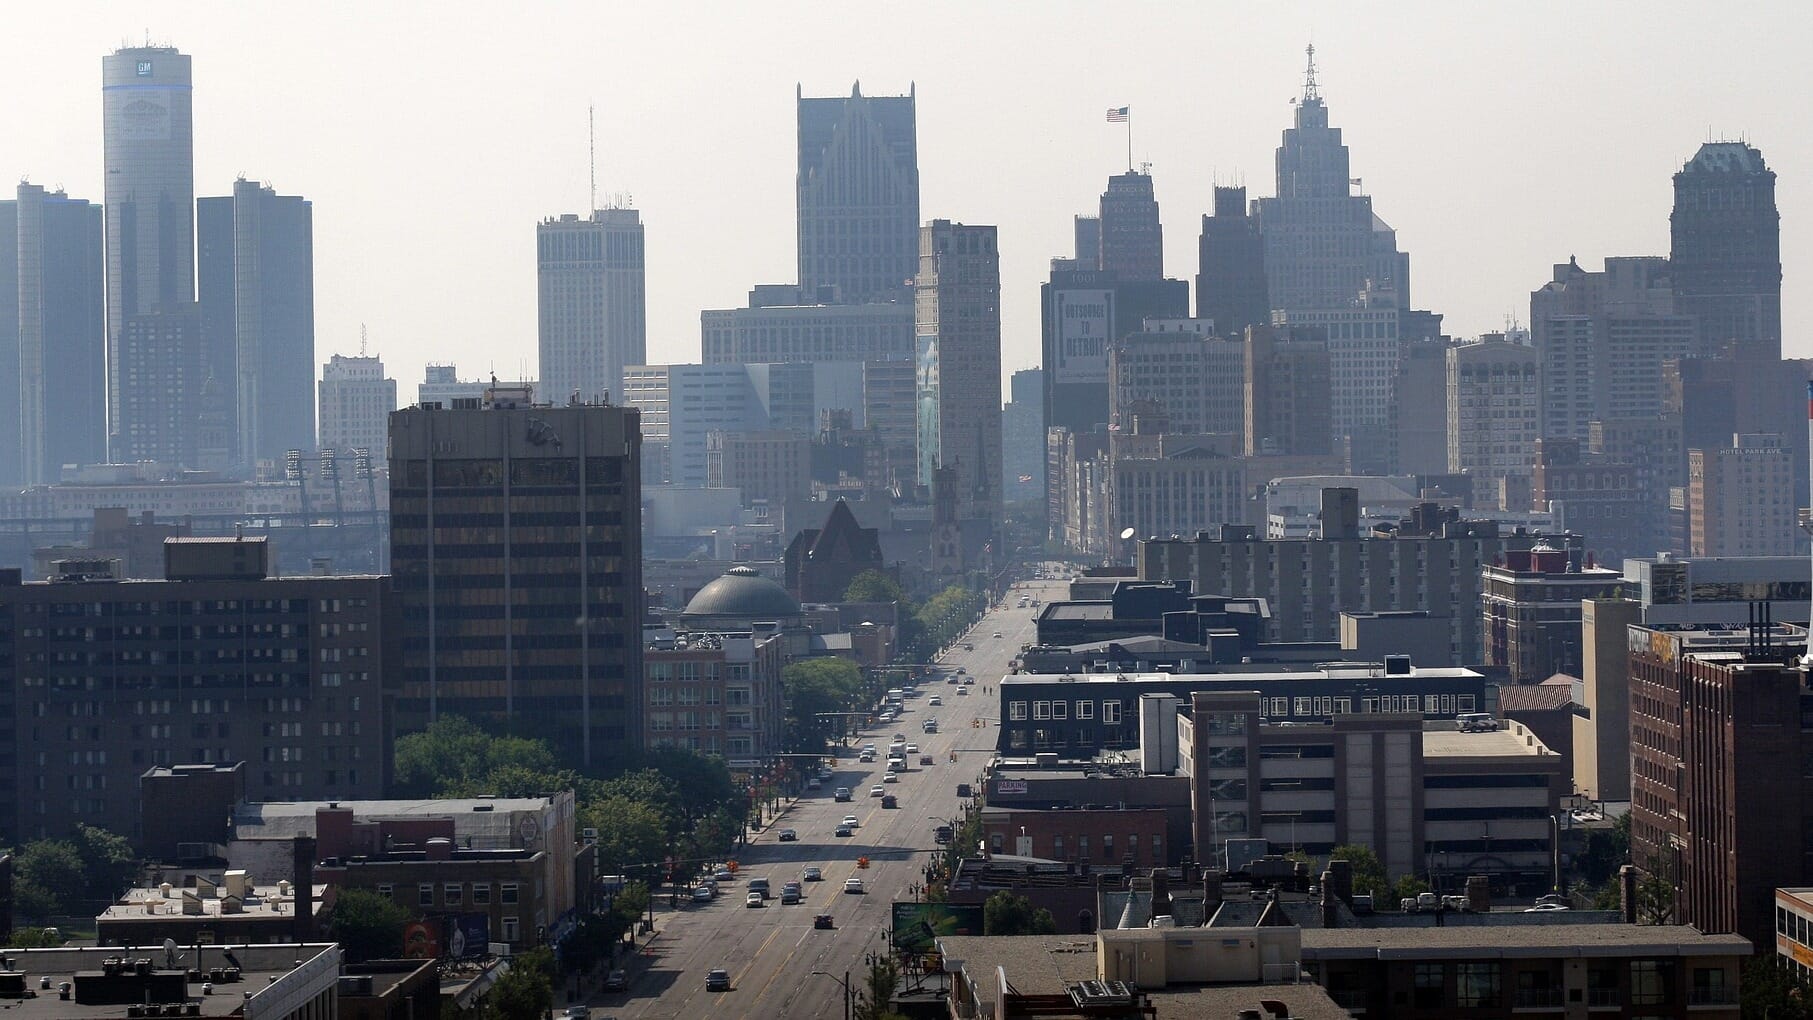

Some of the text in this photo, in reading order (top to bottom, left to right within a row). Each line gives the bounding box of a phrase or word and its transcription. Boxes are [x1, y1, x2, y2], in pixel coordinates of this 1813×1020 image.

[138, 62, 151, 72] GM
[1065, 304, 1104, 318] OUTSOURCE
[1081, 321, 1090, 335] TO
[1066, 338, 1104, 357] DETROIT
[999, 781, 1027, 789] PARKING
